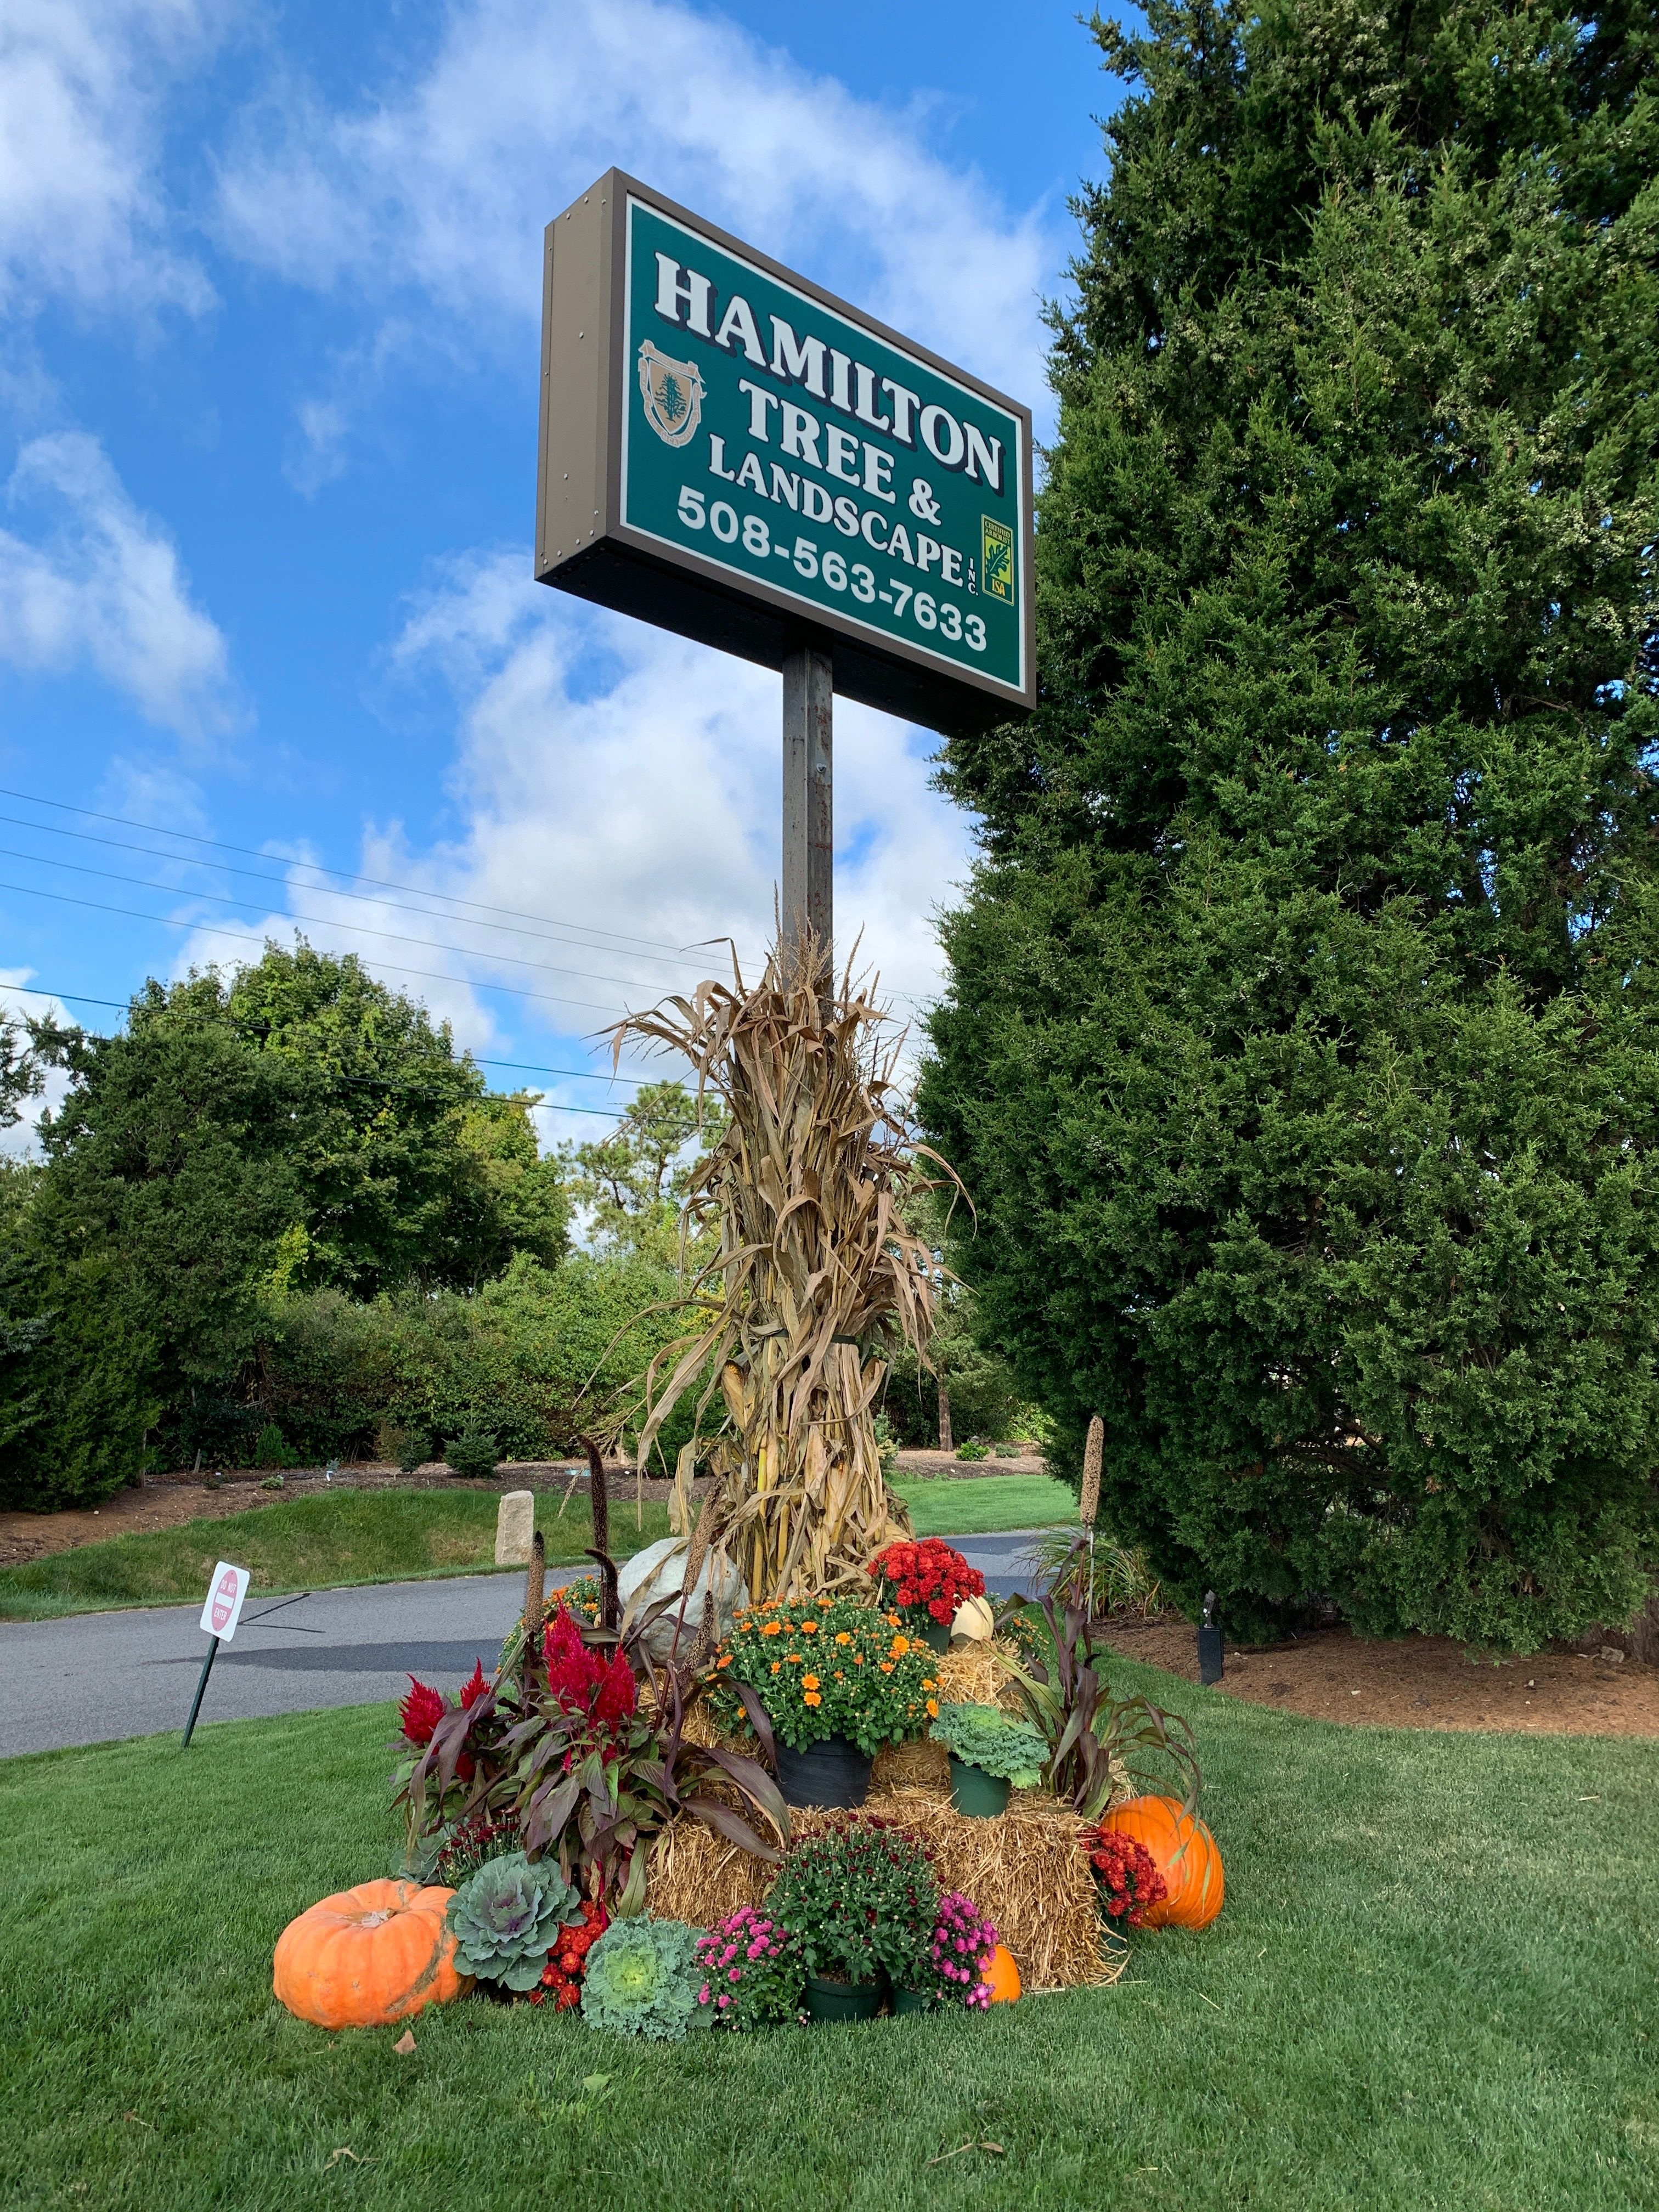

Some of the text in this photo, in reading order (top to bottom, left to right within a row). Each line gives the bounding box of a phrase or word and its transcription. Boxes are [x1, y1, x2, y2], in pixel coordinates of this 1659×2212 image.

[654, 252, 1002, 490] HAMILTON
[738, 379, 896, 505] TREE
[909, 478, 942, 526] &
[709, 433, 978, 596] LANDSCAPE INC.
[985, 521, 1010, 538] CERTIFIED
[985, 528, 1011, 545] ARBORIST
[677, 484, 987, 652] 508-563-7633
[992, 578, 1006, 596] ISA
[220, 1579, 236, 1594] DO NOT
[214, 1607, 227, 1621] ENTER
